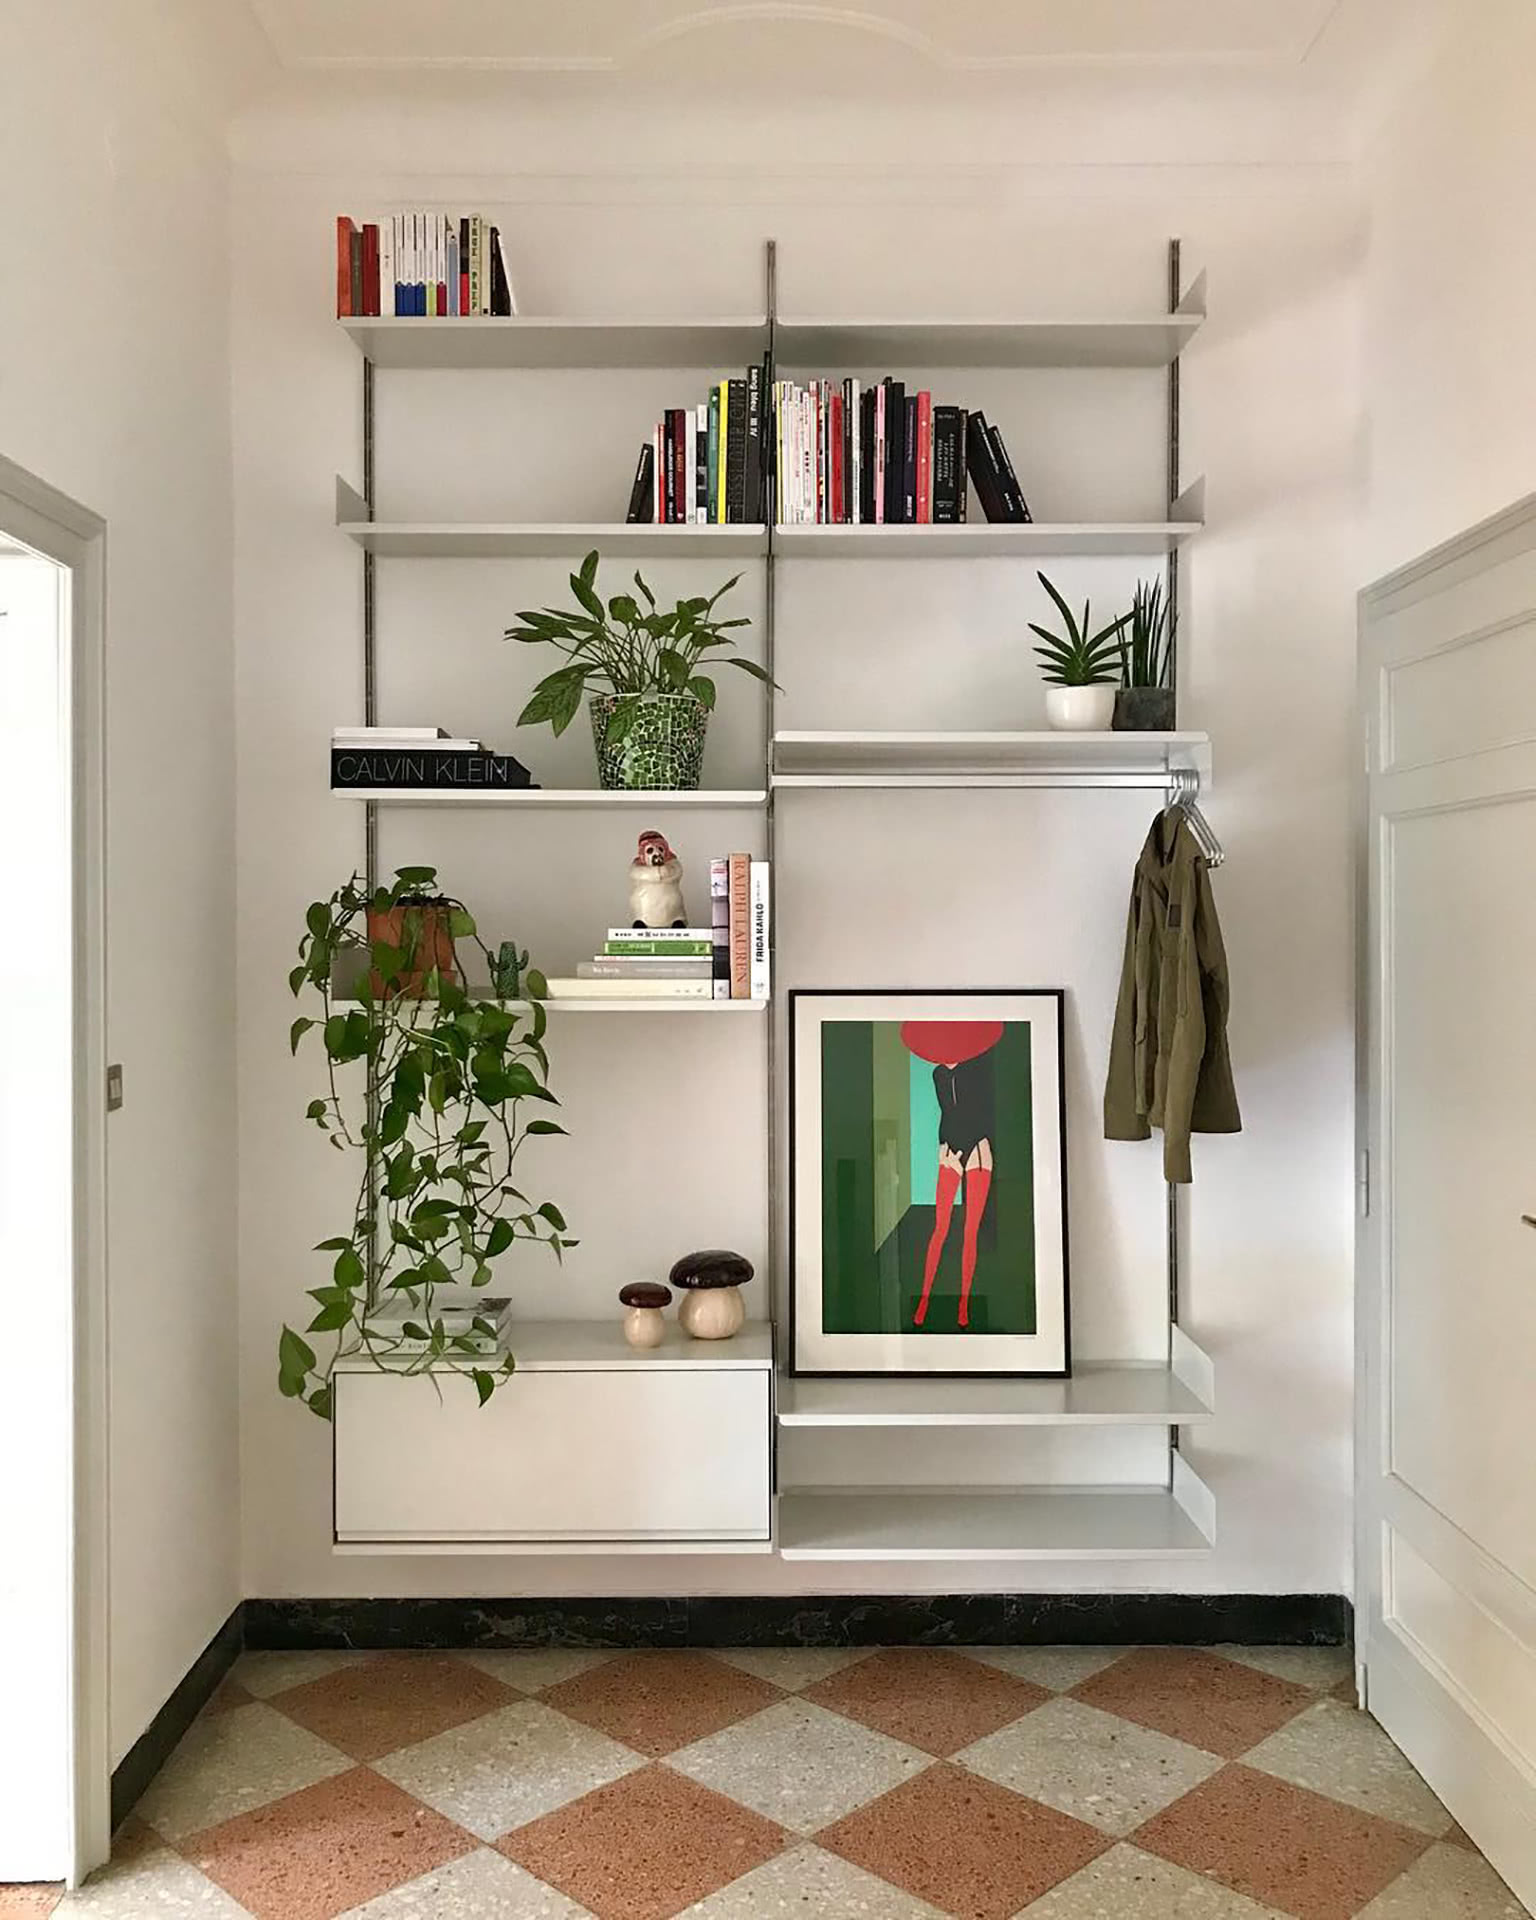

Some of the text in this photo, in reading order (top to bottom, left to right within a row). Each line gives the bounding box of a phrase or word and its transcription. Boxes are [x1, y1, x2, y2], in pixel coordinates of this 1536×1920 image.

[749, 368, 758, 390] sang
[750, 391, 759, 412] bleu
[336, 756, 508, 783] CALVIN KLEIN
[734, 860, 748, 984] RALPH LAUREN
[755, 903, 765, 934] KAHLO
[755, 936, 765, 963] FRIDA
